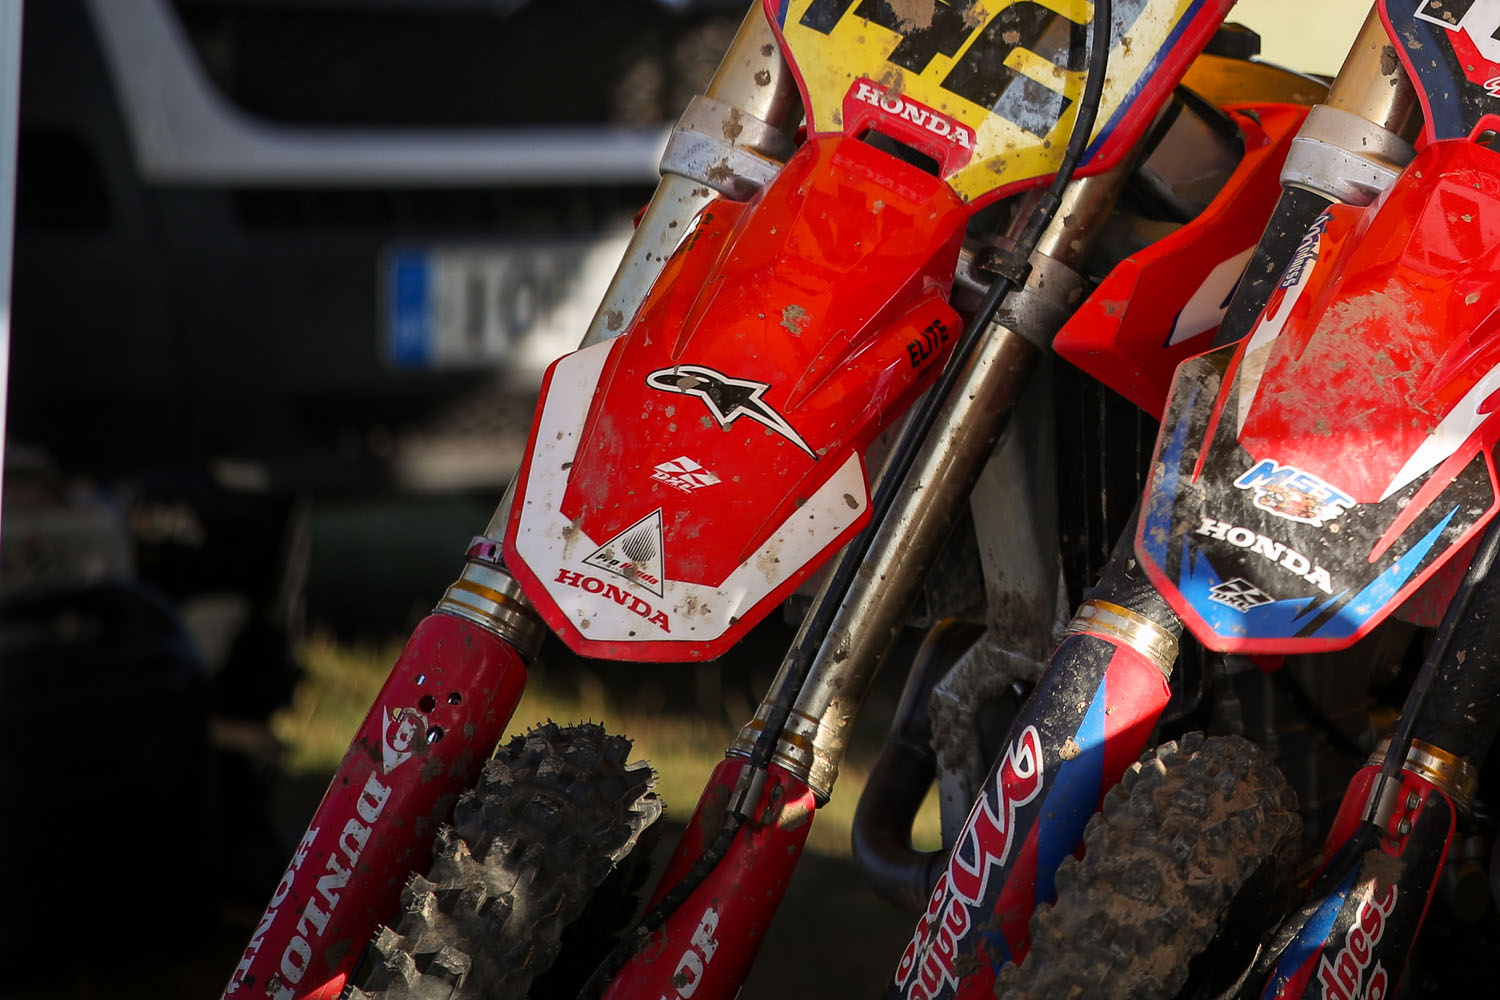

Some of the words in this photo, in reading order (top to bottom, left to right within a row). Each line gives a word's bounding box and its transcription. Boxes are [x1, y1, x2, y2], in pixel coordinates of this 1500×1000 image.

[856, 83, 972, 149] HONDA
[619, 561, 659, 586] Hnda
[1196, 518, 1334, 595] HONDA
[553, 568, 672, 634] HONDA
[222, 826, 320, 1000] HOND
